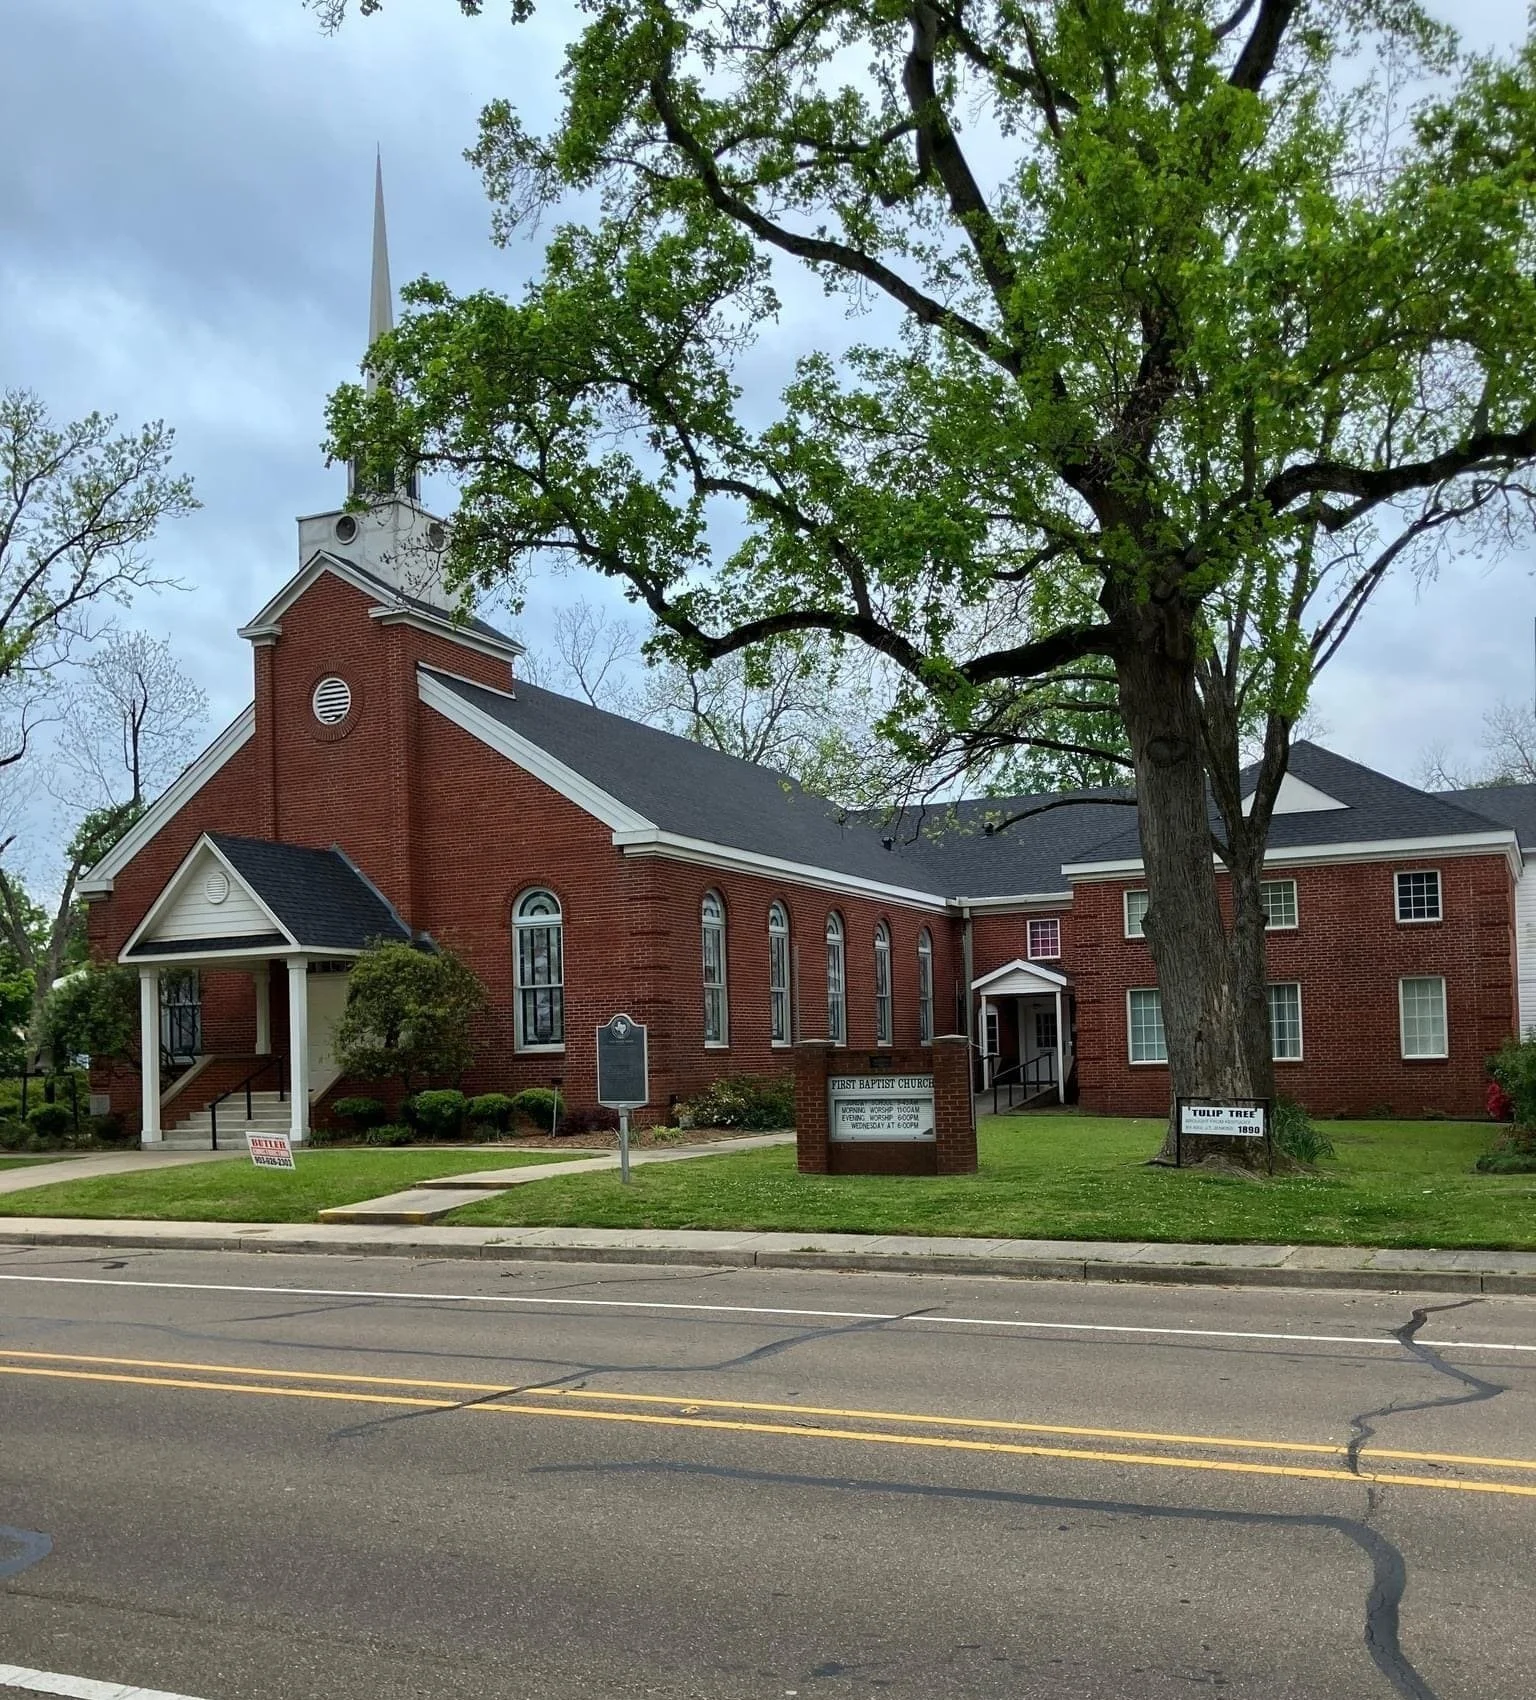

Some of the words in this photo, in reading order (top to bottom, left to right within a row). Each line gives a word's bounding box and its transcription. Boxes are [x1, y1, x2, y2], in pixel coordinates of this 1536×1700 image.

[831, 1080, 857, 1090] FIRST
[859, 1079, 896, 1089] BAPTIST
[897, 1078, 935, 1089] CHURCH
[1192, 1109, 1223, 1117] TULIP
[1228, 1110, 1256, 1118] TREE
[1238, 1126, 1260, 1134] 1890
[251, 1139, 286, 1148] BUTLER
